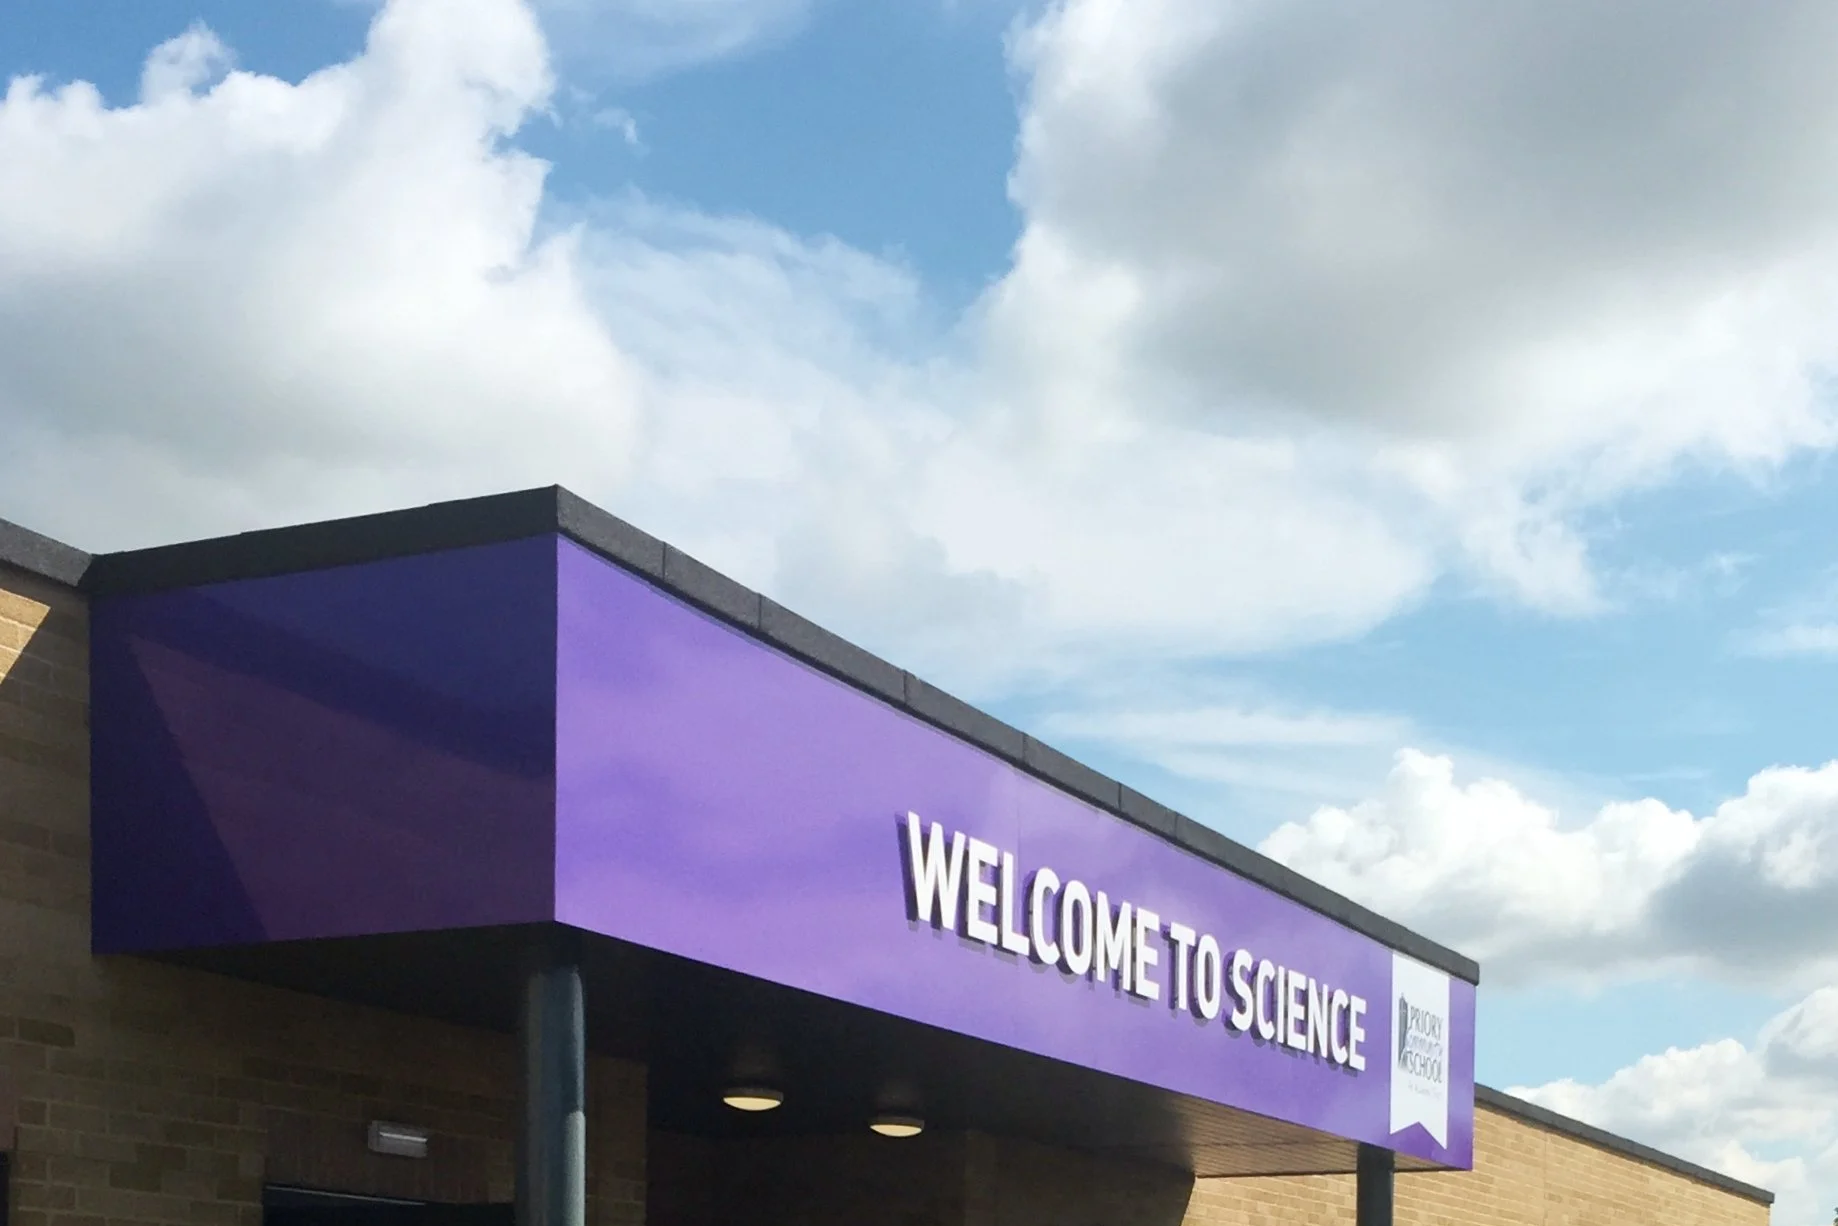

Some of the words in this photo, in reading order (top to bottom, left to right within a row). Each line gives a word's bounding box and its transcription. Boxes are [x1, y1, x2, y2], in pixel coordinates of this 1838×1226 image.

[907, 811, 1160, 1001] WELCOME
[1170, 922, 1221, 1020] TO
[1232, 948, 1367, 1071] SCIENCE
[1408, 1006, 1443, 1041] PRIORY
[1407, 1050, 1443, 1084] SCHOOL
